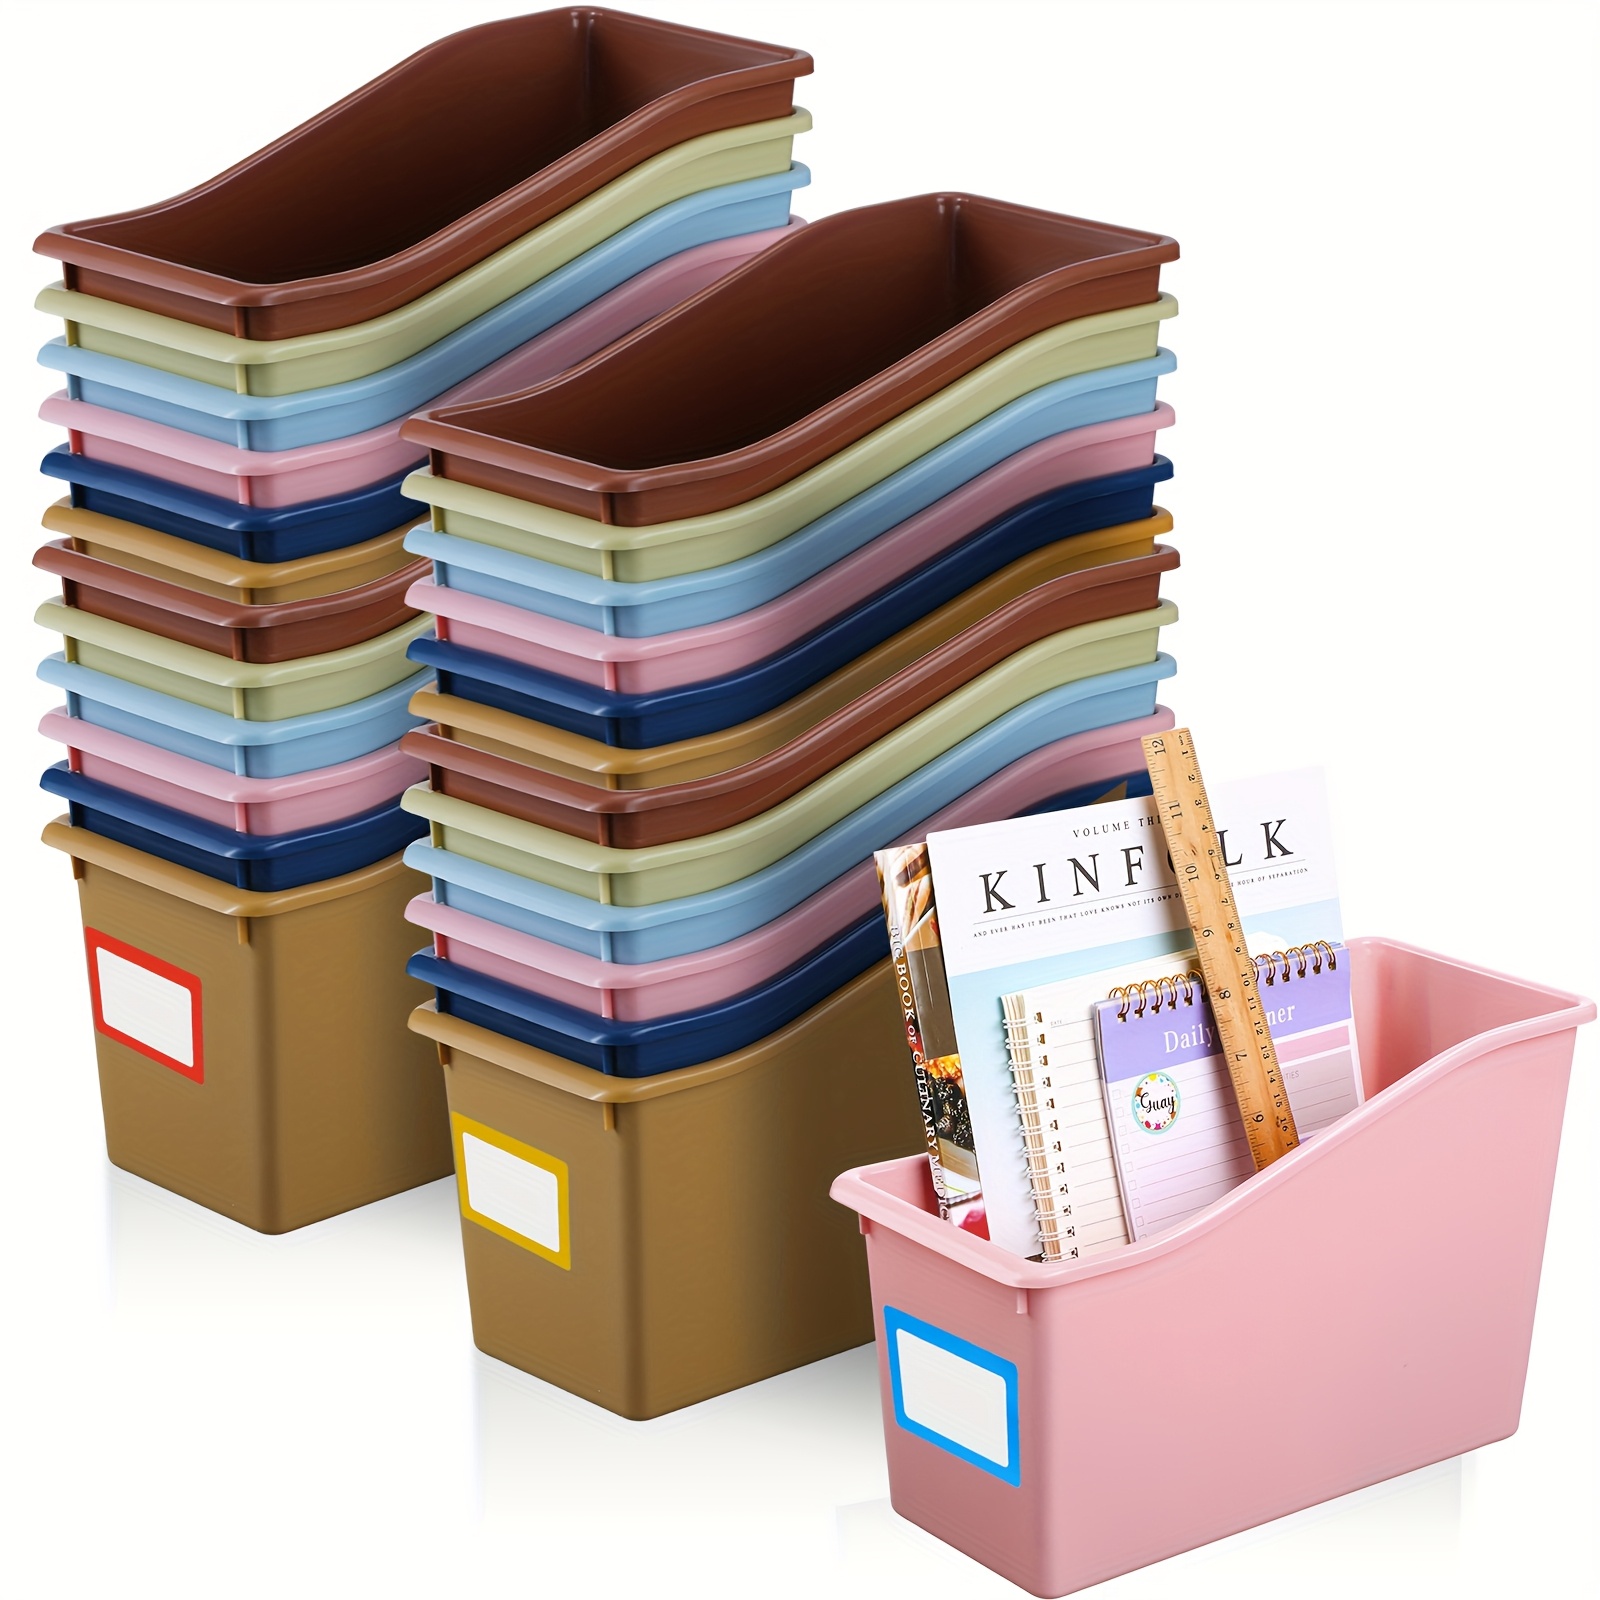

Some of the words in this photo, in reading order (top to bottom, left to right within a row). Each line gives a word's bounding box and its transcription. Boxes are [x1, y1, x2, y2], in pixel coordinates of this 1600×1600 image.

[1151, 738, 1166, 755] 12
[1169, 802, 1183, 819] 11
[1072, 820, 1131, 838] VOLUME
[978, 818, 1294, 914] KINFLK
[1185, 865, 1200, 882] 10
[973, 930, 988, 938] AND
[990, 926, 1008, 935] EVER
[1011, 923, 1025, 931] HAS
[1038, 917, 1056, 925] BEEN
[1059, 912, 1077, 921] THAT
[1080, 909, 1098, 917] LOVE
[1101, 903, 1125, 913] KNOWS
[1127, 900, 1141, 908] NOT
[1143, 897, 1155, 905] ITS
[1157, 894, 1172, 902] OWN
[1237, 878, 1254, 886] HOUR
[1268, 867, 1308, 880] SEPARATION
[1202, 929, 1215, 938] 9
[1188, 774, 1196, 782] 2
[1194, 799, 1202, 807] 3
[1241, 972, 1251, 987] 10
[1247, 996, 1257, 1011] 11
[1254, 1021, 1264, 1036] 12
[1260, 1045, 1270, 1060] 13
[1267, 1069, 1276, 1084] 14
[1273, 1093, 1283, 1108] 15
[1280, 1117, 1289, 1132] 16
[896, 962, 916, 1022] BOOK
[1219, 989, 1231, 1000] 8
[907, 1025, 918, 1045] OF
[1163, 1023, 1215, 1053] Daily
[1235, 1052, 1247, 1062] 7
[912, 1050, 938, 1152] CULINARY
